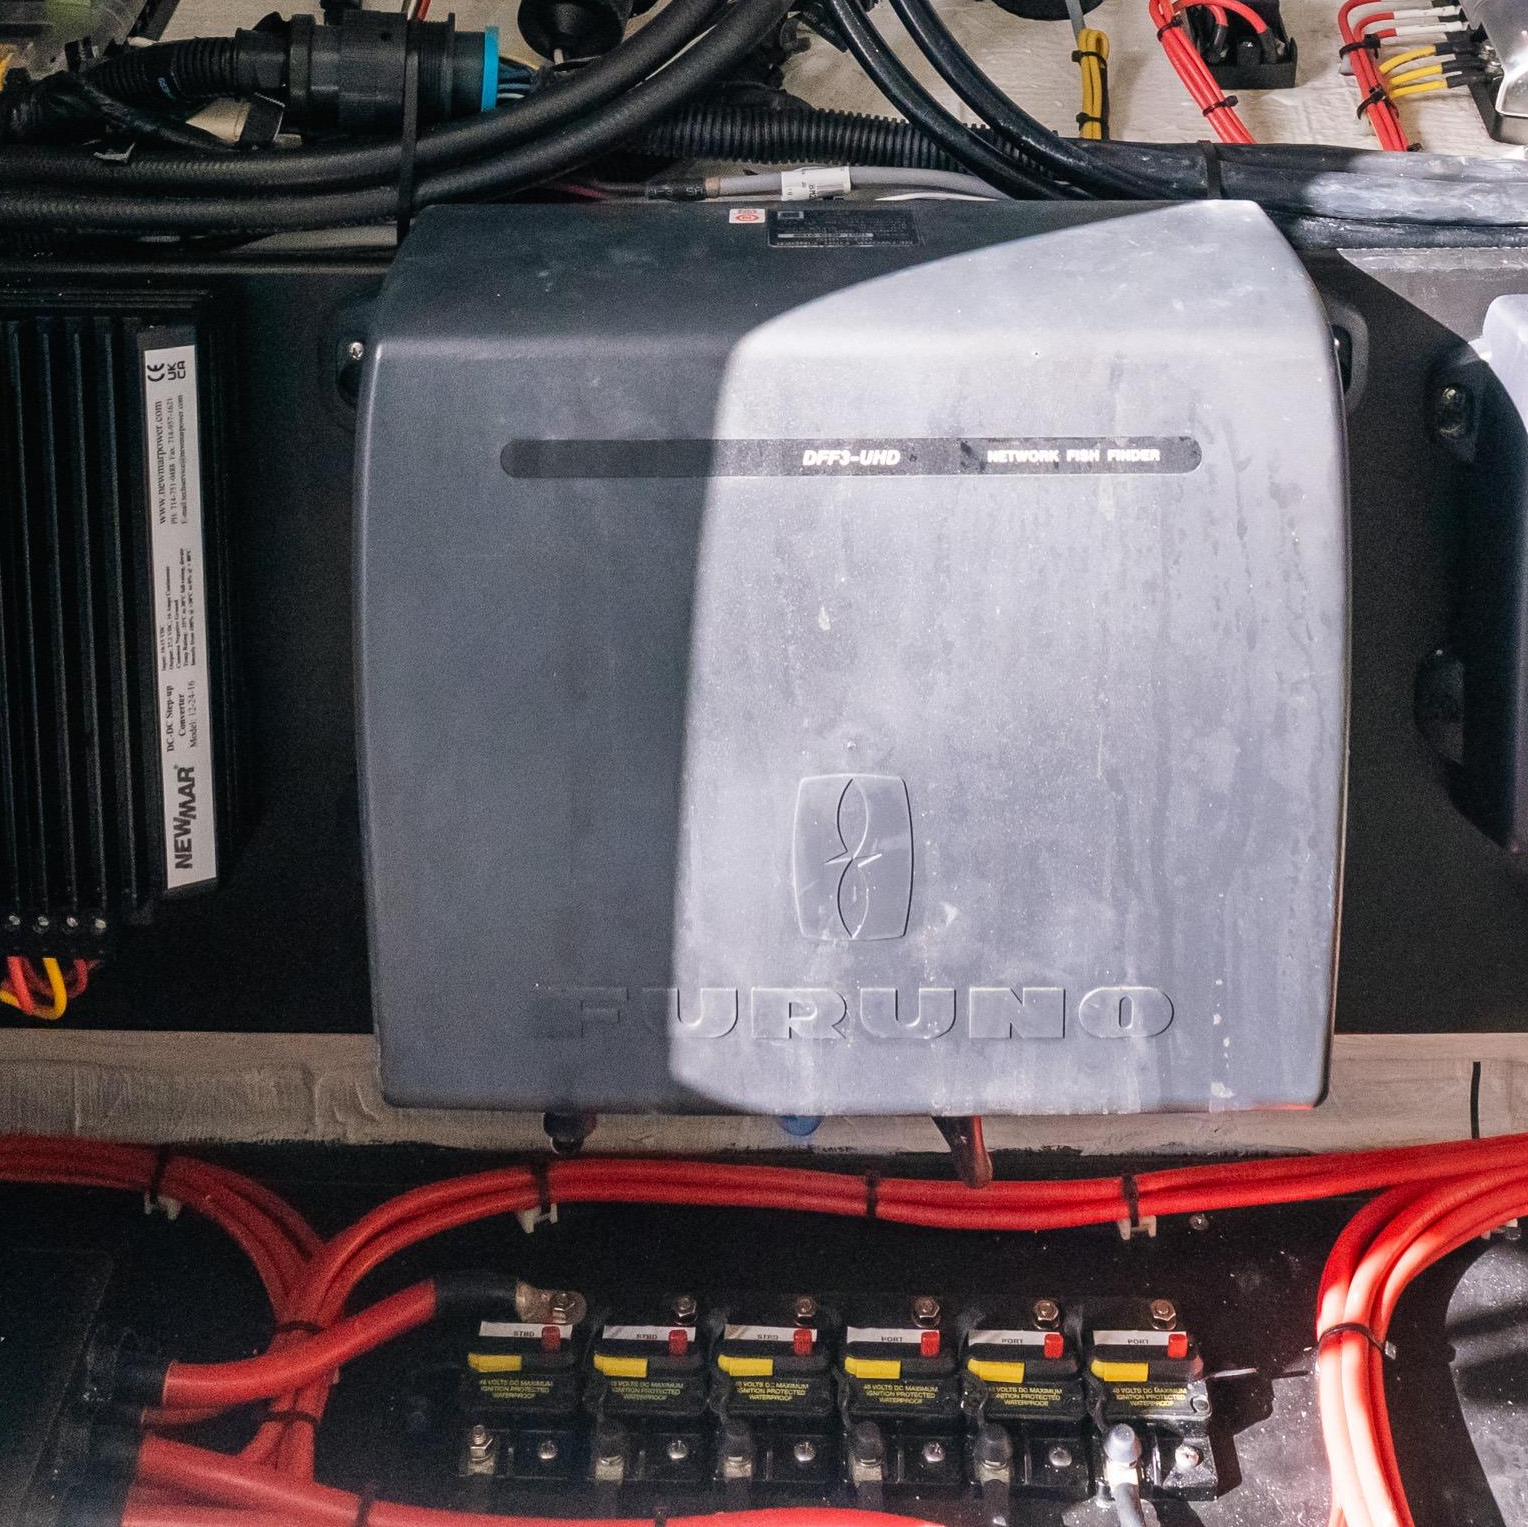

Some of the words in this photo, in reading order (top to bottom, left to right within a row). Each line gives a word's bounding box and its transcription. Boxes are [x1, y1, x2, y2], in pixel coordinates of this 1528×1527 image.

[147, 363, 165, 382] CE
[167, 363, 177, 380] UK
[177, 360, 186, 379] CA
[154, 400, 167, 524] www.newmarpower.com
[803, 449, 902, 466] DFF3-UHD
[987, 449, 1060, 463] NETWORK
[1066, 448, 1100, 462] FISH
[1106, 449, 1161, 462] FINDER
[165, 685, 174, 719] Step-up
[177, 693, 186, 737] Converter
[166, 723, 175, 752] DC-DC
[173, 766, 197, 869] NEWMAR
[532, 985, 1176, 1041] FURUNO
